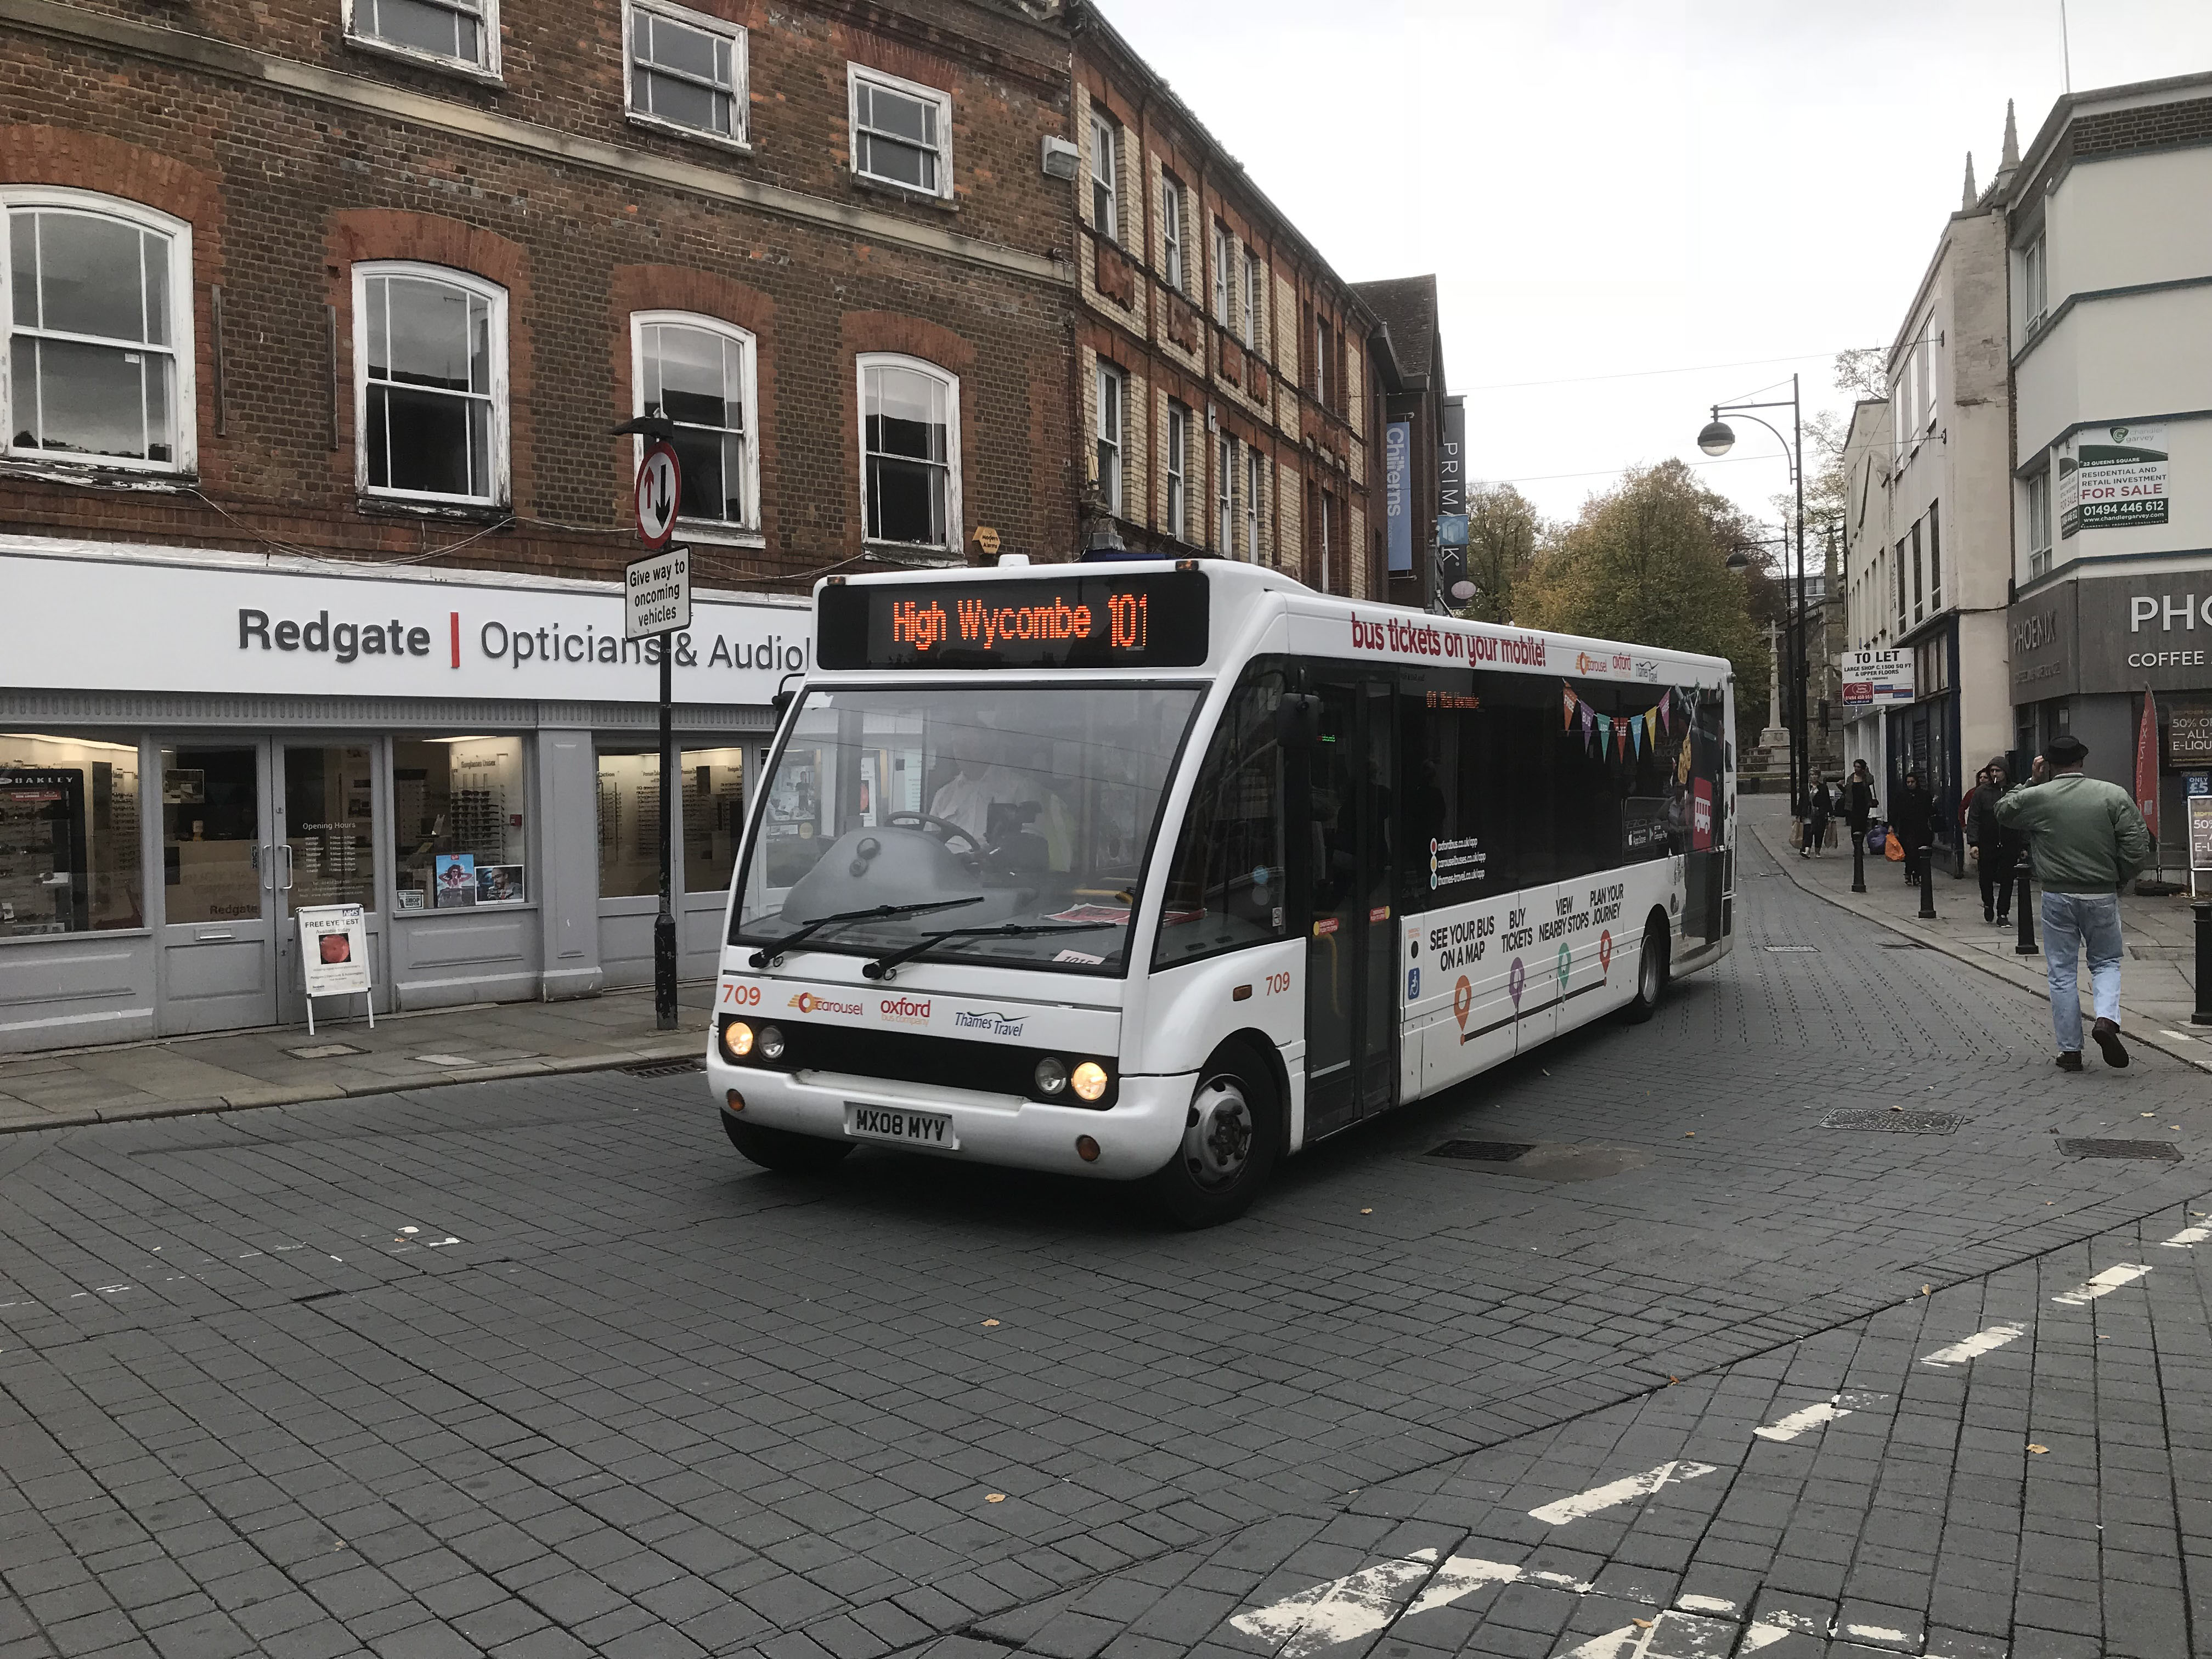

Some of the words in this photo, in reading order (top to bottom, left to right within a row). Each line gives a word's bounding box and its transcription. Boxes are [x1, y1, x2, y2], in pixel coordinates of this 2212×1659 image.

[2126, 435, 2154, 443] garvey
[2130, 427, 2162, 436] chandler
[1386, 427, 1404, 516] Chilterns
[2082, 469, 2136, 478] RESIDENTIAL
[2113, 475, 2166, 484] INVESTMENT
[1442, 442, 1460, 562] PRIMK
[2081, 488, 2115, 500] FOR
[2121, 483, 2163, 496] SALE
[2084, 505, 2117, 516] 01494
[2120, 502, 2142, 513] 446
[2145, 500, 2164, 511] 612
[2084, 512, 2164, 522] www.chandlergarvey.com
[630, 570, 650, 587] Give
[653, 565, 672, 580] way
[675, 559, 685, 574] to
[635, 583, 680, 607] oncoming
[639, 605, 676, 627] vehicles
[894, 601, 946, 650] High
[958, 597, 1091, 649] Wycombe
[1108, 594, 1147, 646] 101
[239, 608, 430, 663] Redgate
[481, 621, 661, 669] Opticians
[675, 632, 697, 667] &
[1351, 611, 1384, 651] bus
[1387, 617, 1441, 656] tickets
[1444, 631, 1463, 658] on
[1466, 634, 1497, 667] your
[1500, 635, 1546, 667] mobile!
[2013, 611, 2055, 653] PHOENIX
[1855, 652, 1871, 663] TO
[1876, 651, 1899, 662] LET
[2128, 651, 2204, 667] COFFEE
[1582, 712, 1591, 727] BUS
[2172, 719, 2196, 727] 50%
[2187, 730, 2209, 738] ALL
[2189, 782, 2208, 793] £5
[1556, 896, 1573, 916] VIEW
[1590, 888, 1606, 907] PLAN
[1607, 883, 1624, 902] YOUR
[210, 905, 257, 916] Redgate
[1509, 907, 1526, 929] BUY
[1592, 902, 1621, 926] JOURNEY
[1430, 927, 1448, 951] SEE
[1449, 920, 1475, 944] YOUR
[1477, 916, 1494, 938] BUS
[1539, 917, 1567, 943] NEARBY
[1568, 911, 1589, 933] STOPS
[1502, 927, 1533, 953] TICKETS
[1440, 950, 1454, 972] ON
[1456, 947, 1464, 967] A
[1465, 941, 1485, 964] MAP
[1266, 972, 1290, 996] 709
[723, 984, 761, 1006] 709
[816, 1000, 864, 1015] carousel
[881, 997, 930, 1017] oxford
[896, 1016, 929, 1027] company
[955, 1012, 992, 1029] Thames
[994, 1020, 1023, 1036] Travel
[857, 1109, 903, 1135] MX08
[909, 1116, 945, 1141] MYV
